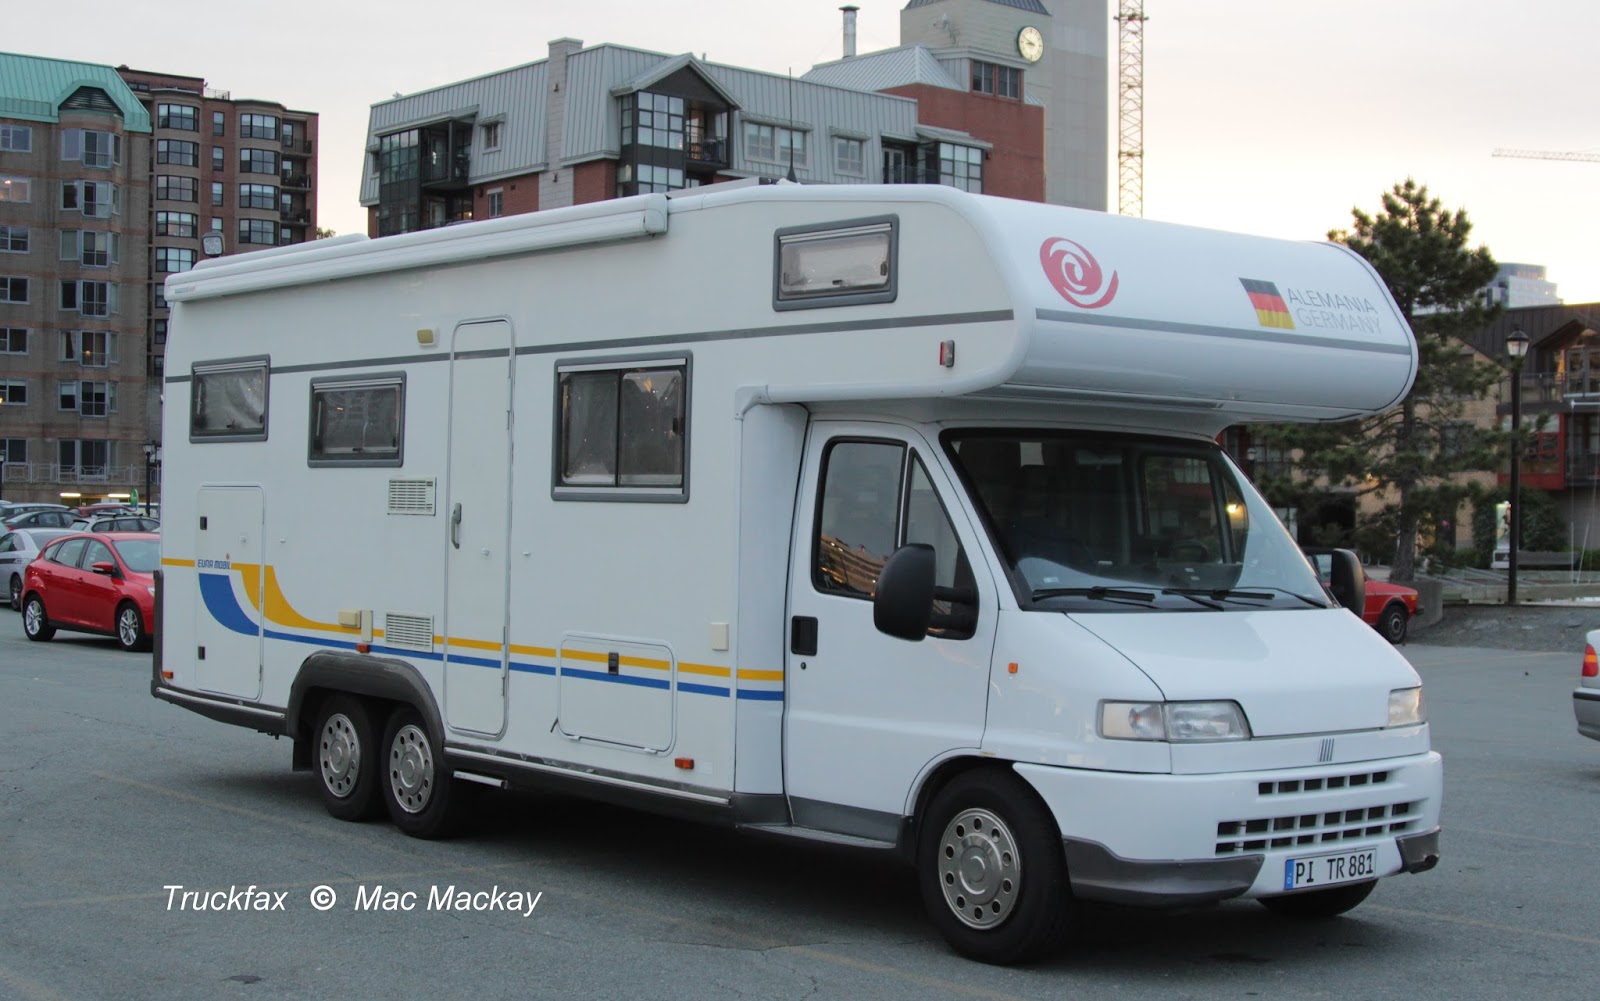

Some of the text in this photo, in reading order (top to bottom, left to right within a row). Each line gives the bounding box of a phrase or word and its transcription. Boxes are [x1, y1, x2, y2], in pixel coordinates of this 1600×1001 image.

[1287, 288, 1378, 314] ALEMANIA
[1296, 307, 1382, 335] GERMANY
[1295, 861, 1314, 884] PI
